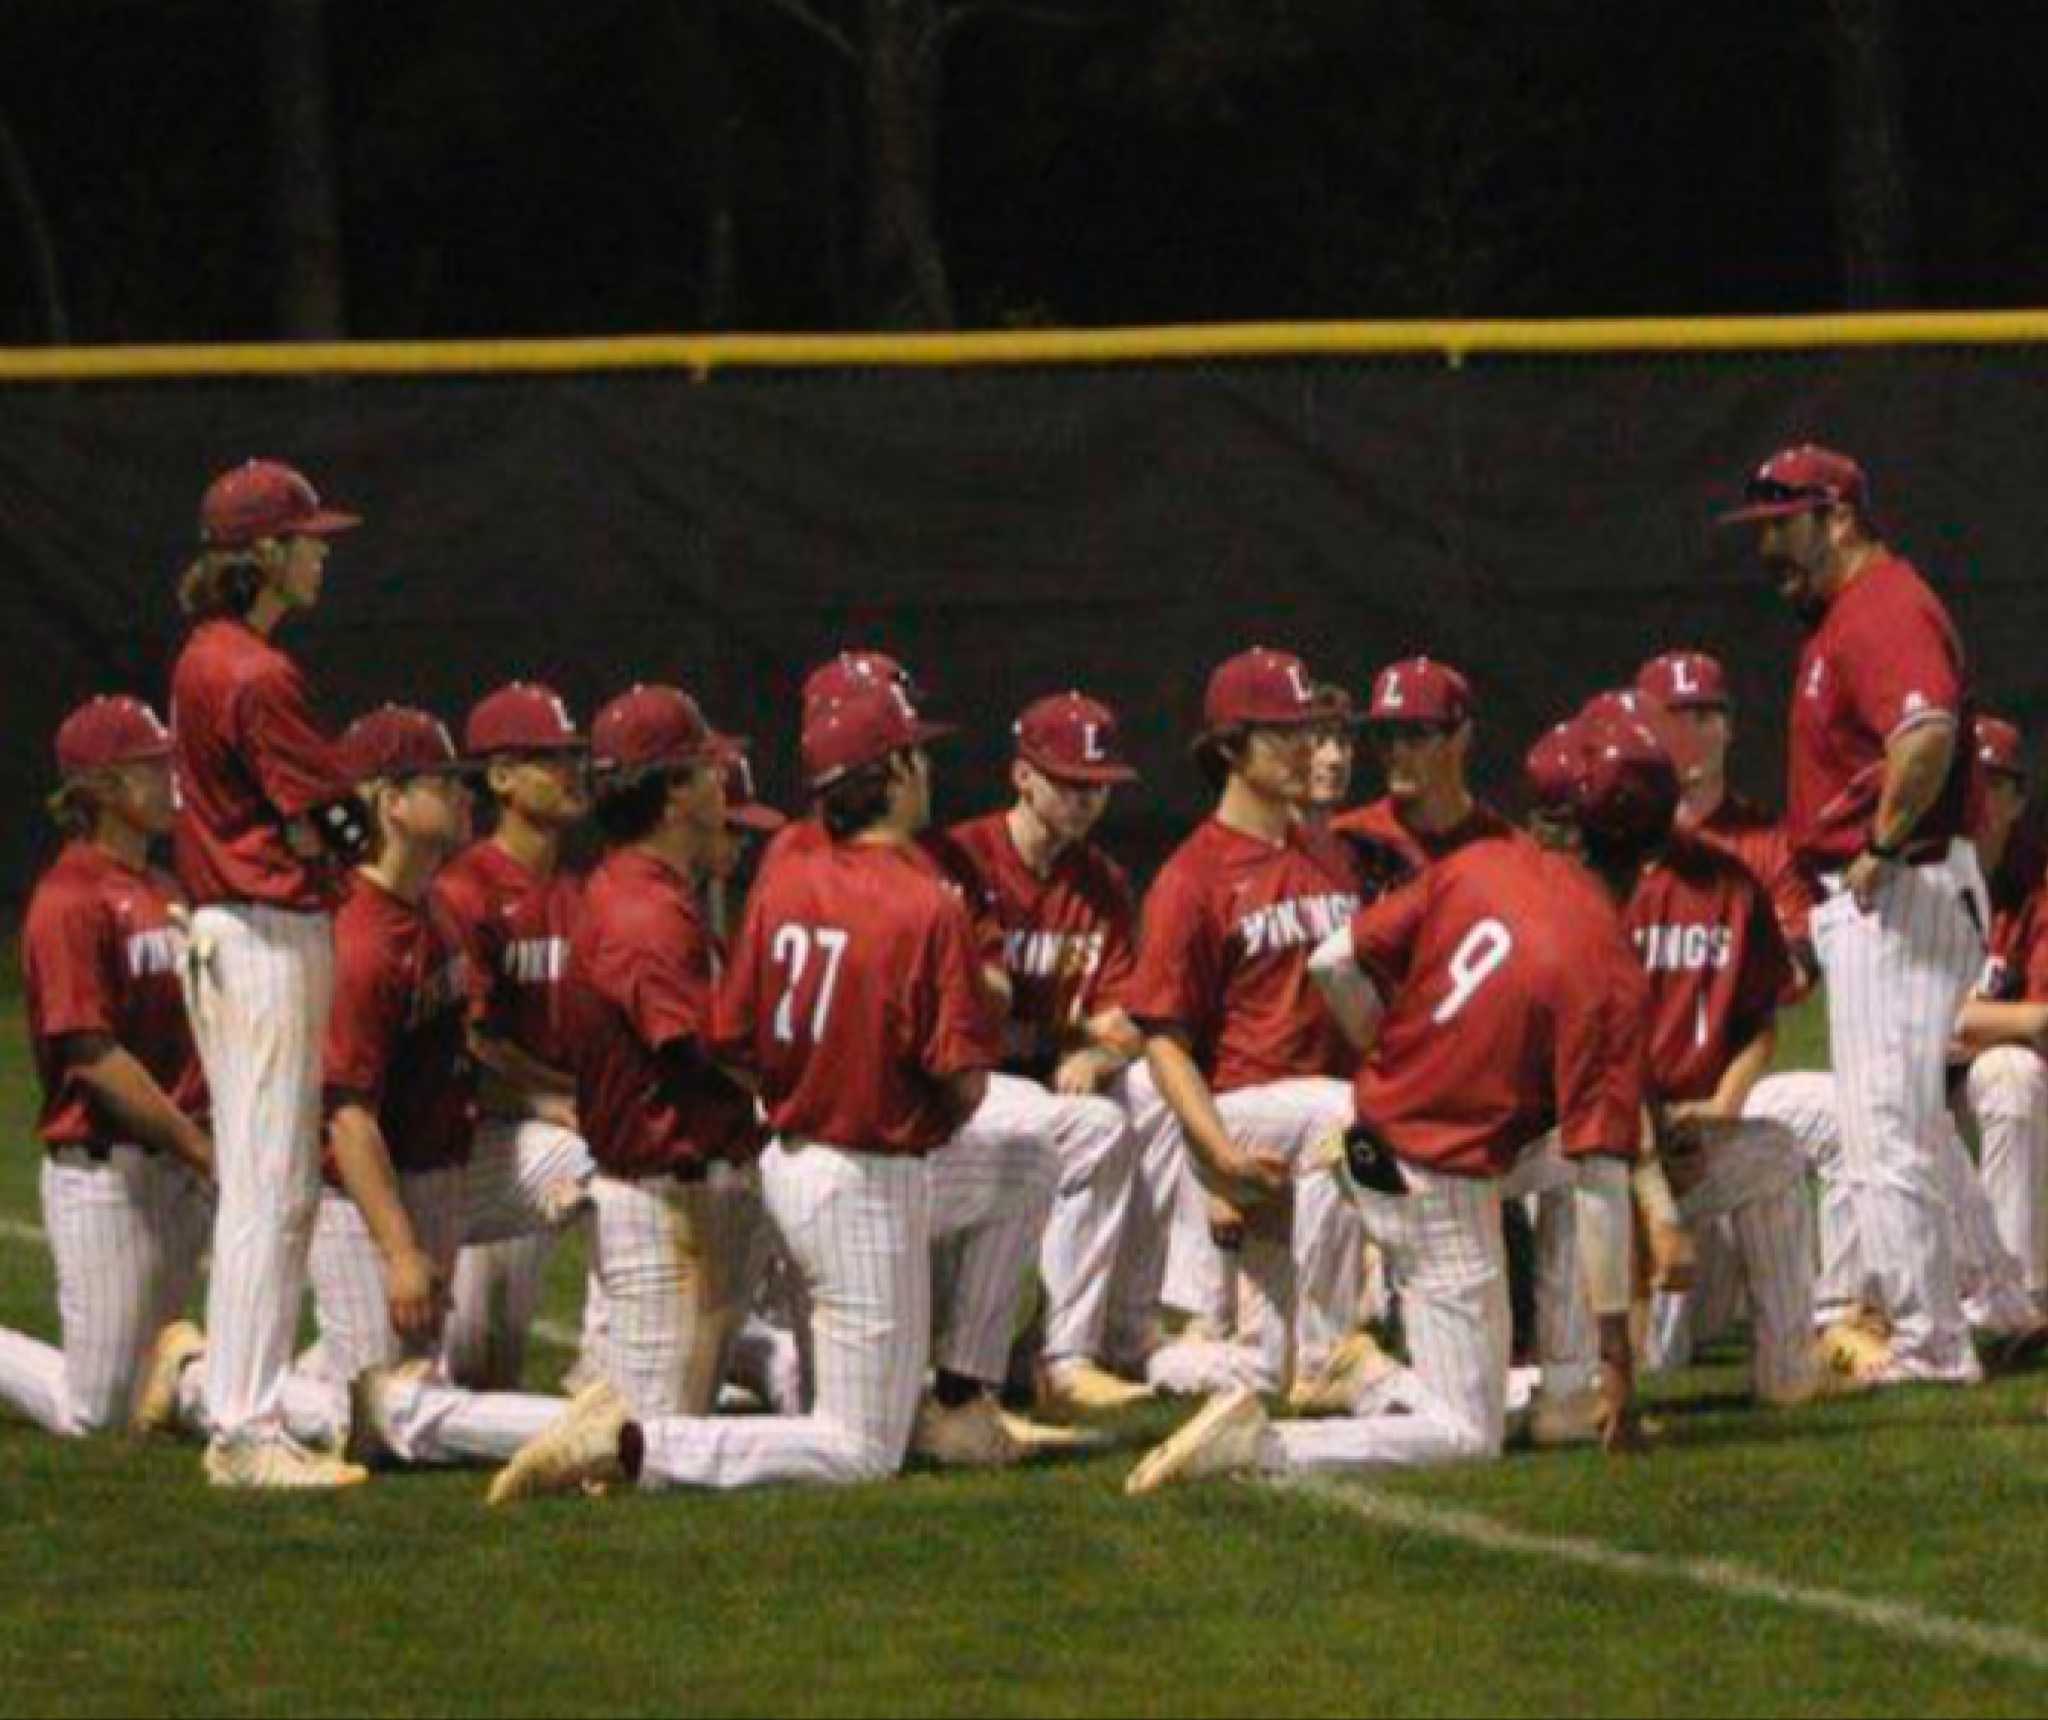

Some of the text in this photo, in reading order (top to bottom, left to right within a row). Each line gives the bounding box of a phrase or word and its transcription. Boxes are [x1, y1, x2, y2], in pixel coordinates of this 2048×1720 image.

[1286, 665, 1313, 702] L
[1383, 664, 1404, 707] L
[1671, 660, 1698, 694] L
[1083, 722, 1105, 761] L
[773, 922, 849, 1042] 27
[1432, 918, 1512, 1023] 9
